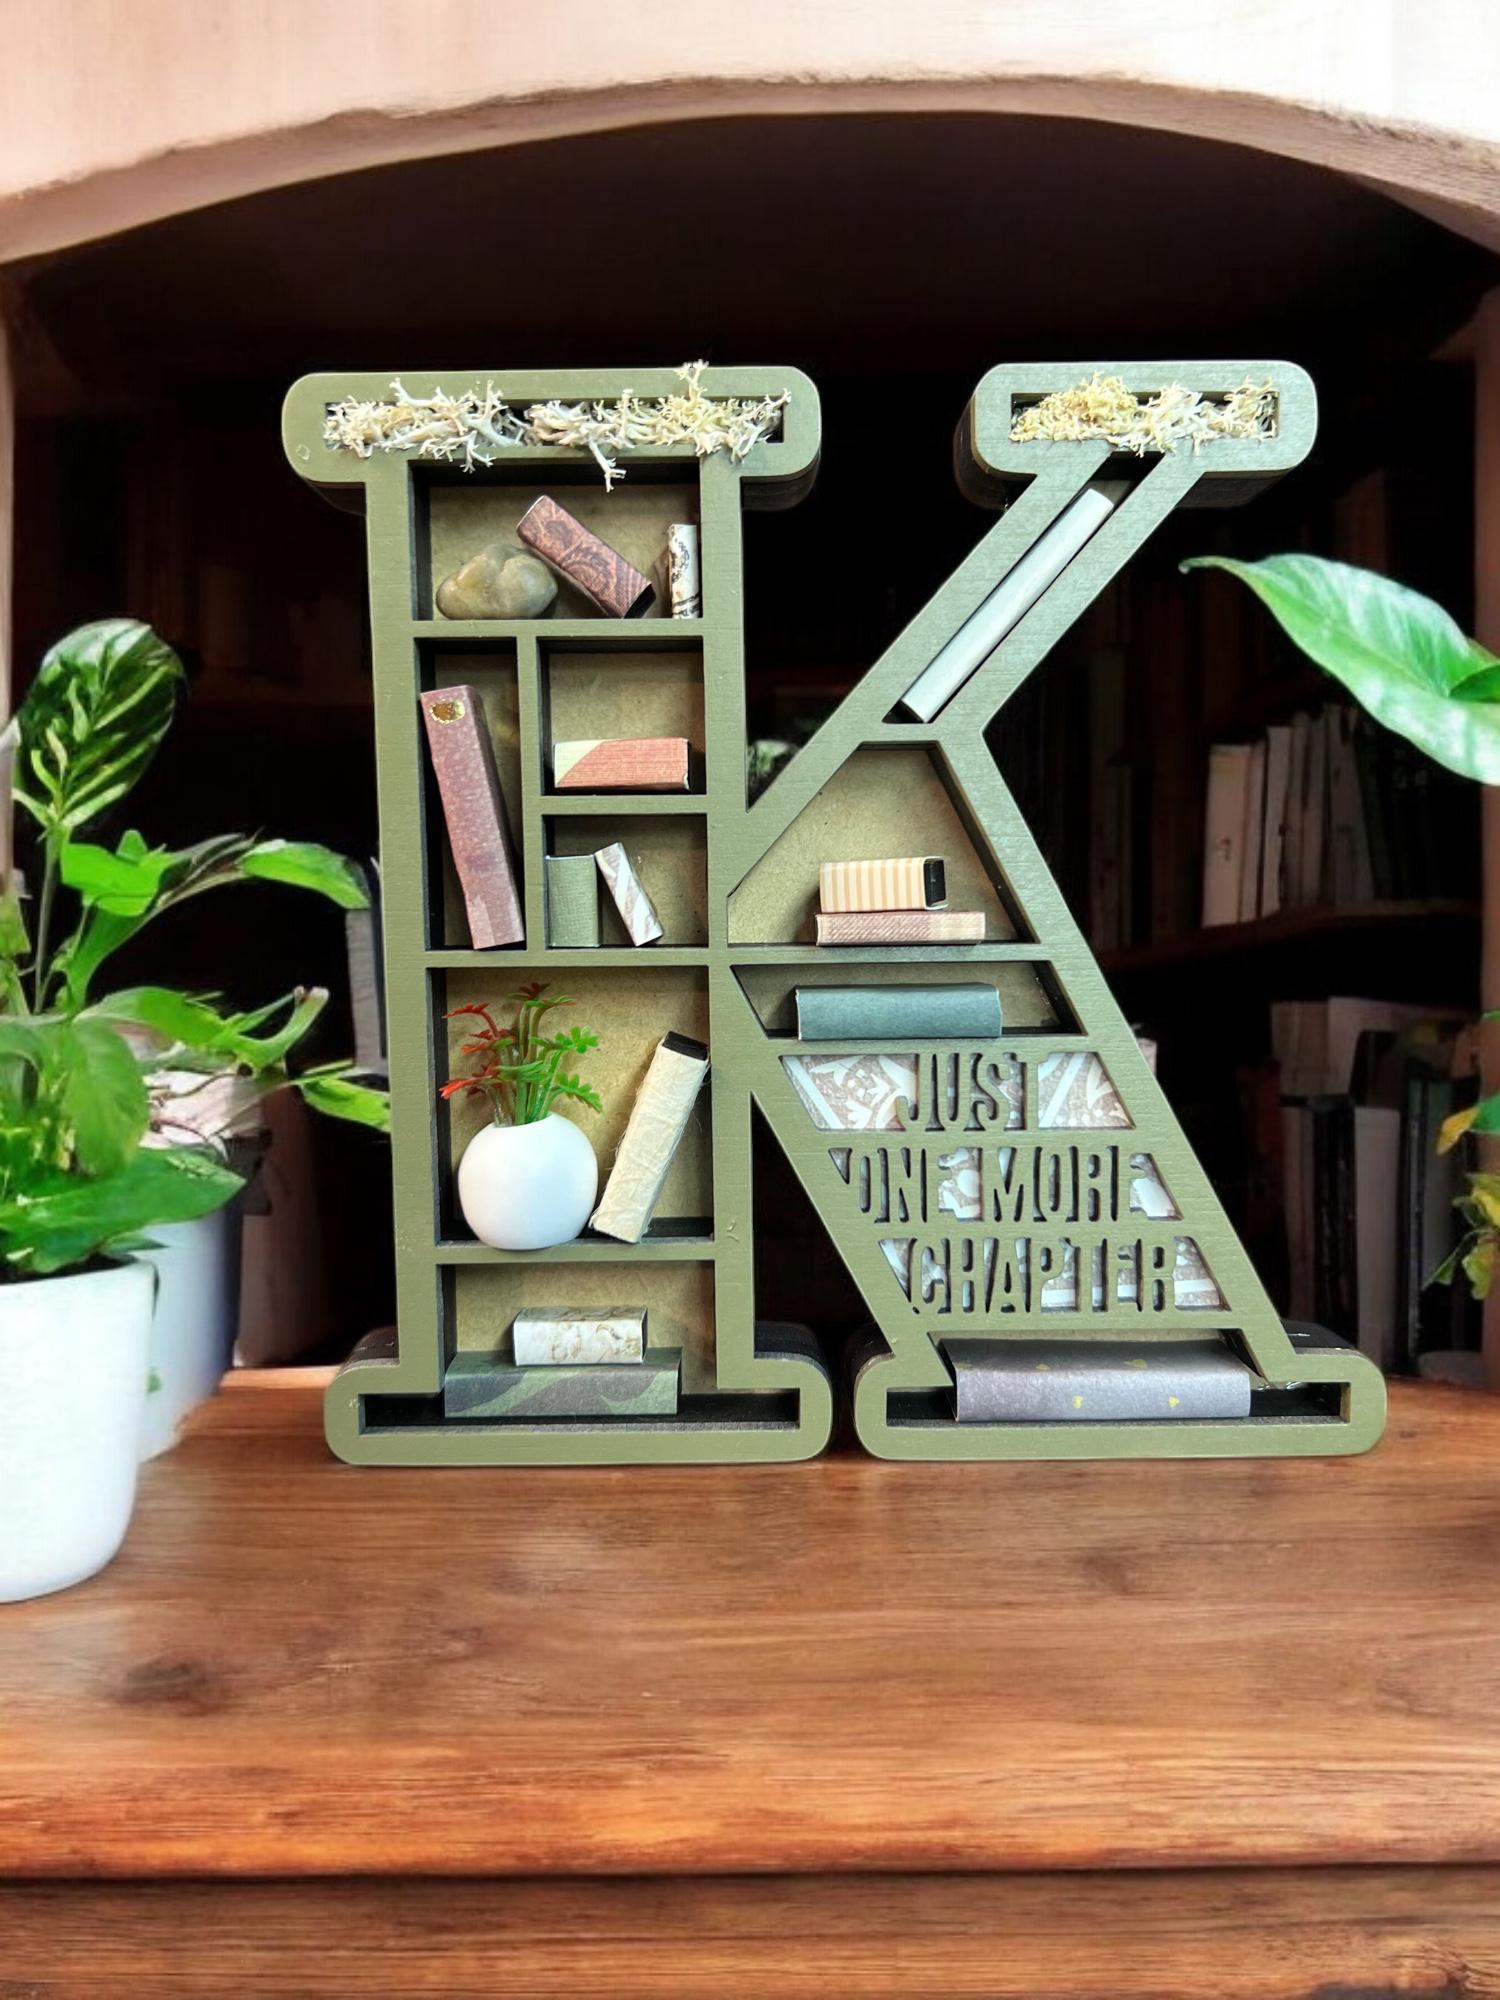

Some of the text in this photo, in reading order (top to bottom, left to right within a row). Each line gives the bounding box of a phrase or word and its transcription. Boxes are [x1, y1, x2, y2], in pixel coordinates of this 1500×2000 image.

[896, 1052, 1047, 1131] JUST
[848, 1146, 1152, 1223] ONE MORE
[910, 1237, 1178, 1313] CHAPTER
